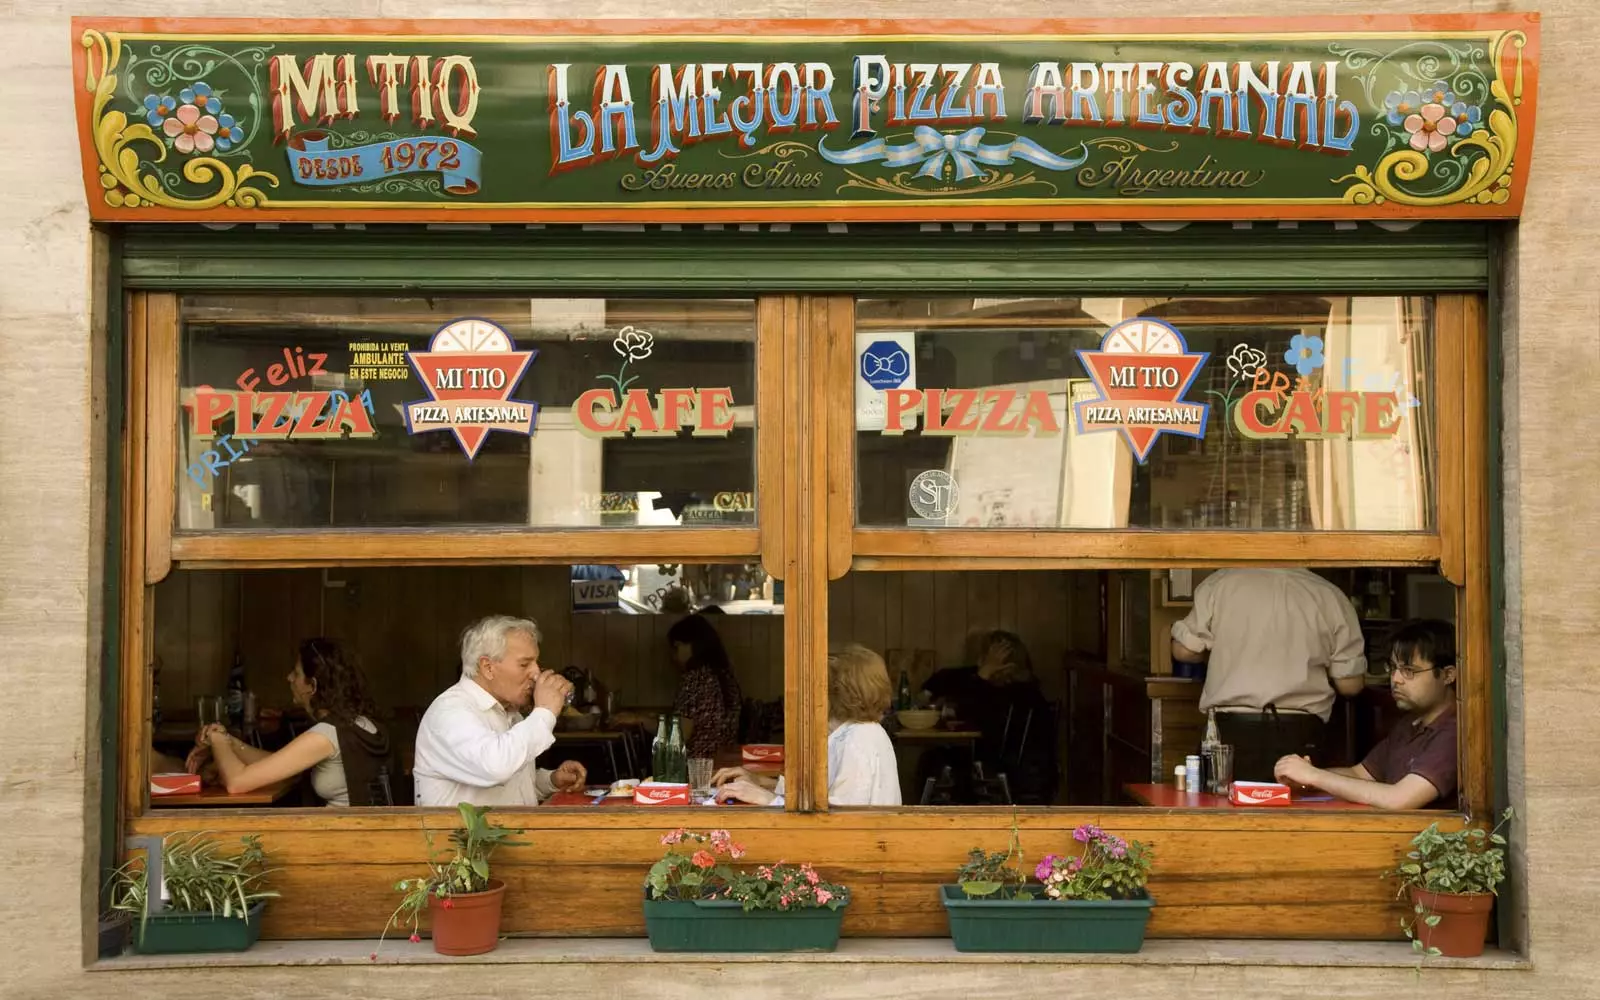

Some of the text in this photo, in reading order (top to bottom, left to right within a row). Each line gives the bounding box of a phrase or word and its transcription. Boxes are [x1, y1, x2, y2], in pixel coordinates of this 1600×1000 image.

[270, 52, 360, 140] MI
[549, 54, 1360, 174] LA MEJOR PIZZA ARTESANAL
[296, 140, 462, 180] DESDE 1972
[621, 159, 824, 191] Buenos Aires
[1077, 155, 1265, 195] Argentina
[349, 342, 409, 351] PROHIBIDA LA VENTA
[353, 352, 404, 365] AMBULANTE
[236, 346, 328, 393] Feliz
[350, 368, 409, 380] EN ESTE NEGOCIO
[435, 367, 506, 390] MI TIO
[1108, 366, 1180, 389] MI TIO
[191, 390, 380, 440] PIZZA
[413, 406, 529, 423] PIZZA ARTESANAL
[572, 387, 737, 438] CAFE
[881, 388, 1061, 436] PIZZA
[1085, 406, 1201, 424] PIZZA ARTESANAL
[1234, 390, 1402, 439] CAFE
[578, 584, 617, 600] VISA
